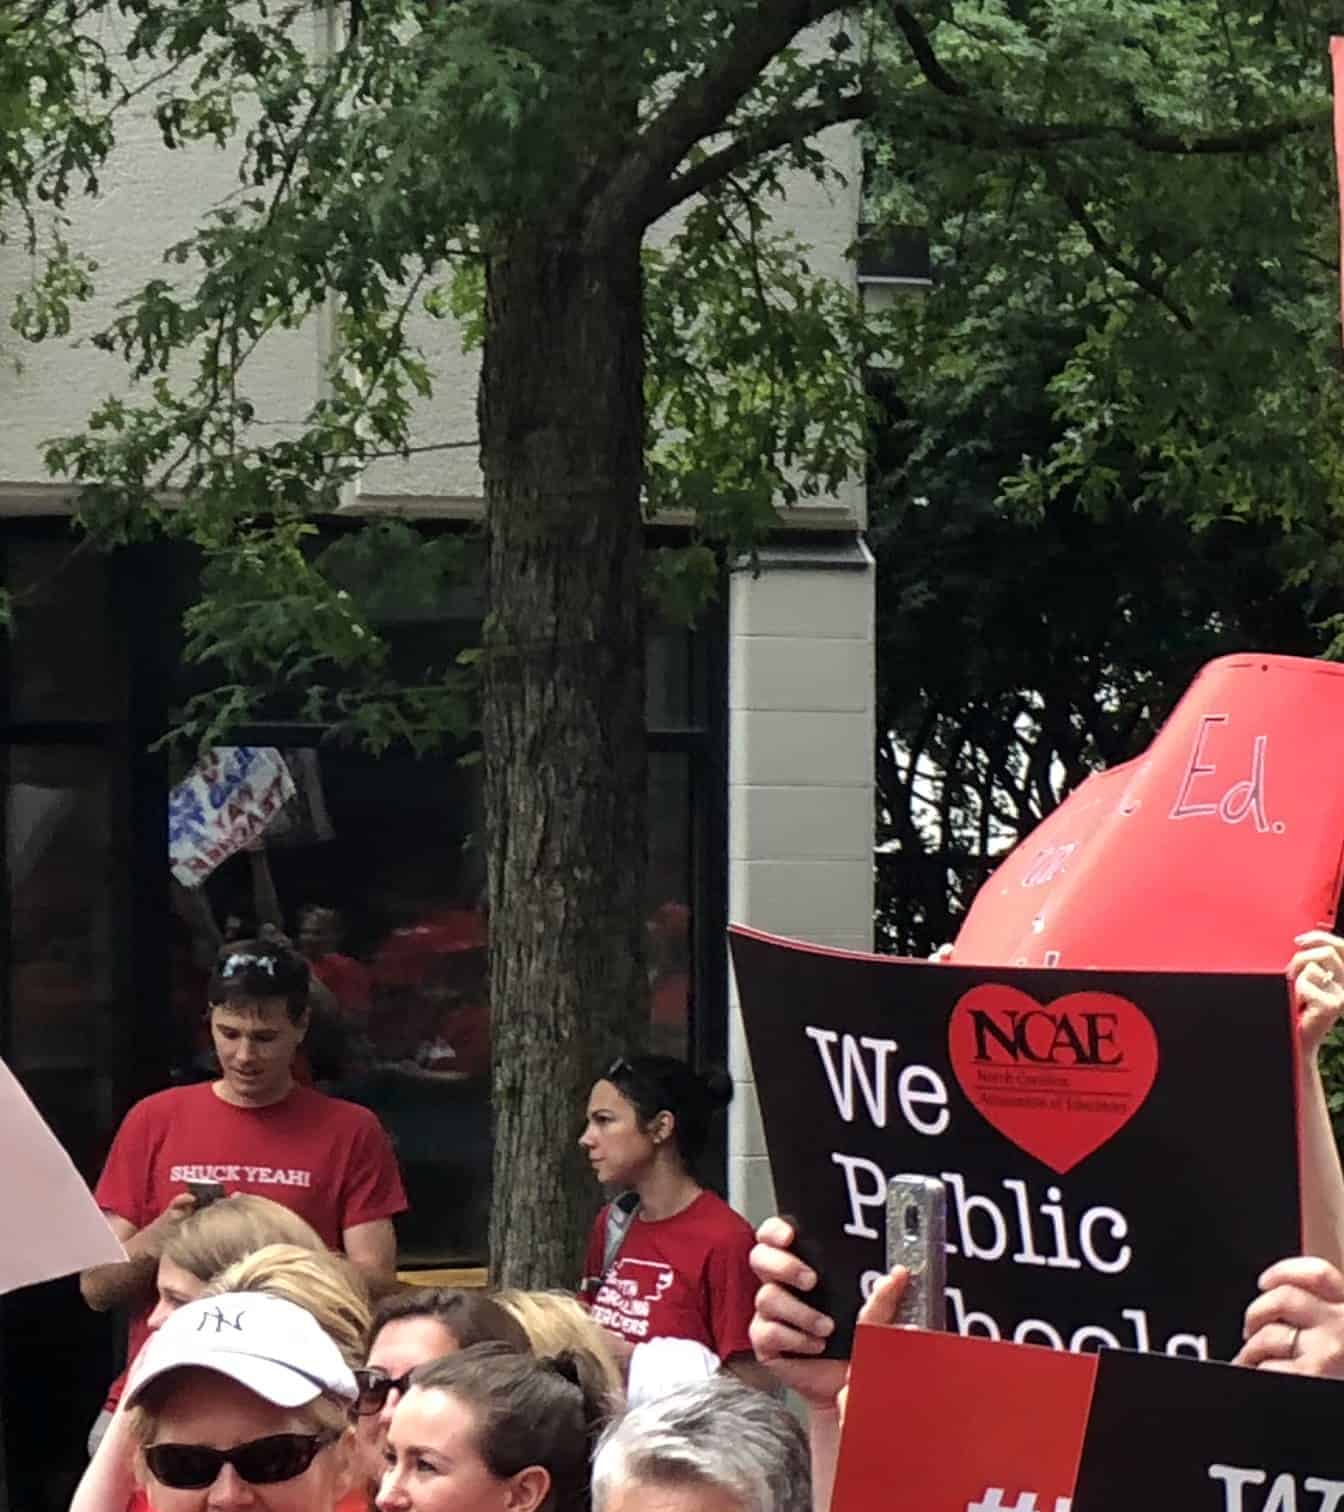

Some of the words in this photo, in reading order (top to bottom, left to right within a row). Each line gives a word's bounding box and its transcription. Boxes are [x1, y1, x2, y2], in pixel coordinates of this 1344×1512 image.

[805, 1026, 950, 1135] We
[967, 1010, 1124, 1065] NCAE
[832, 1151, 1132, 1273] Pblic
